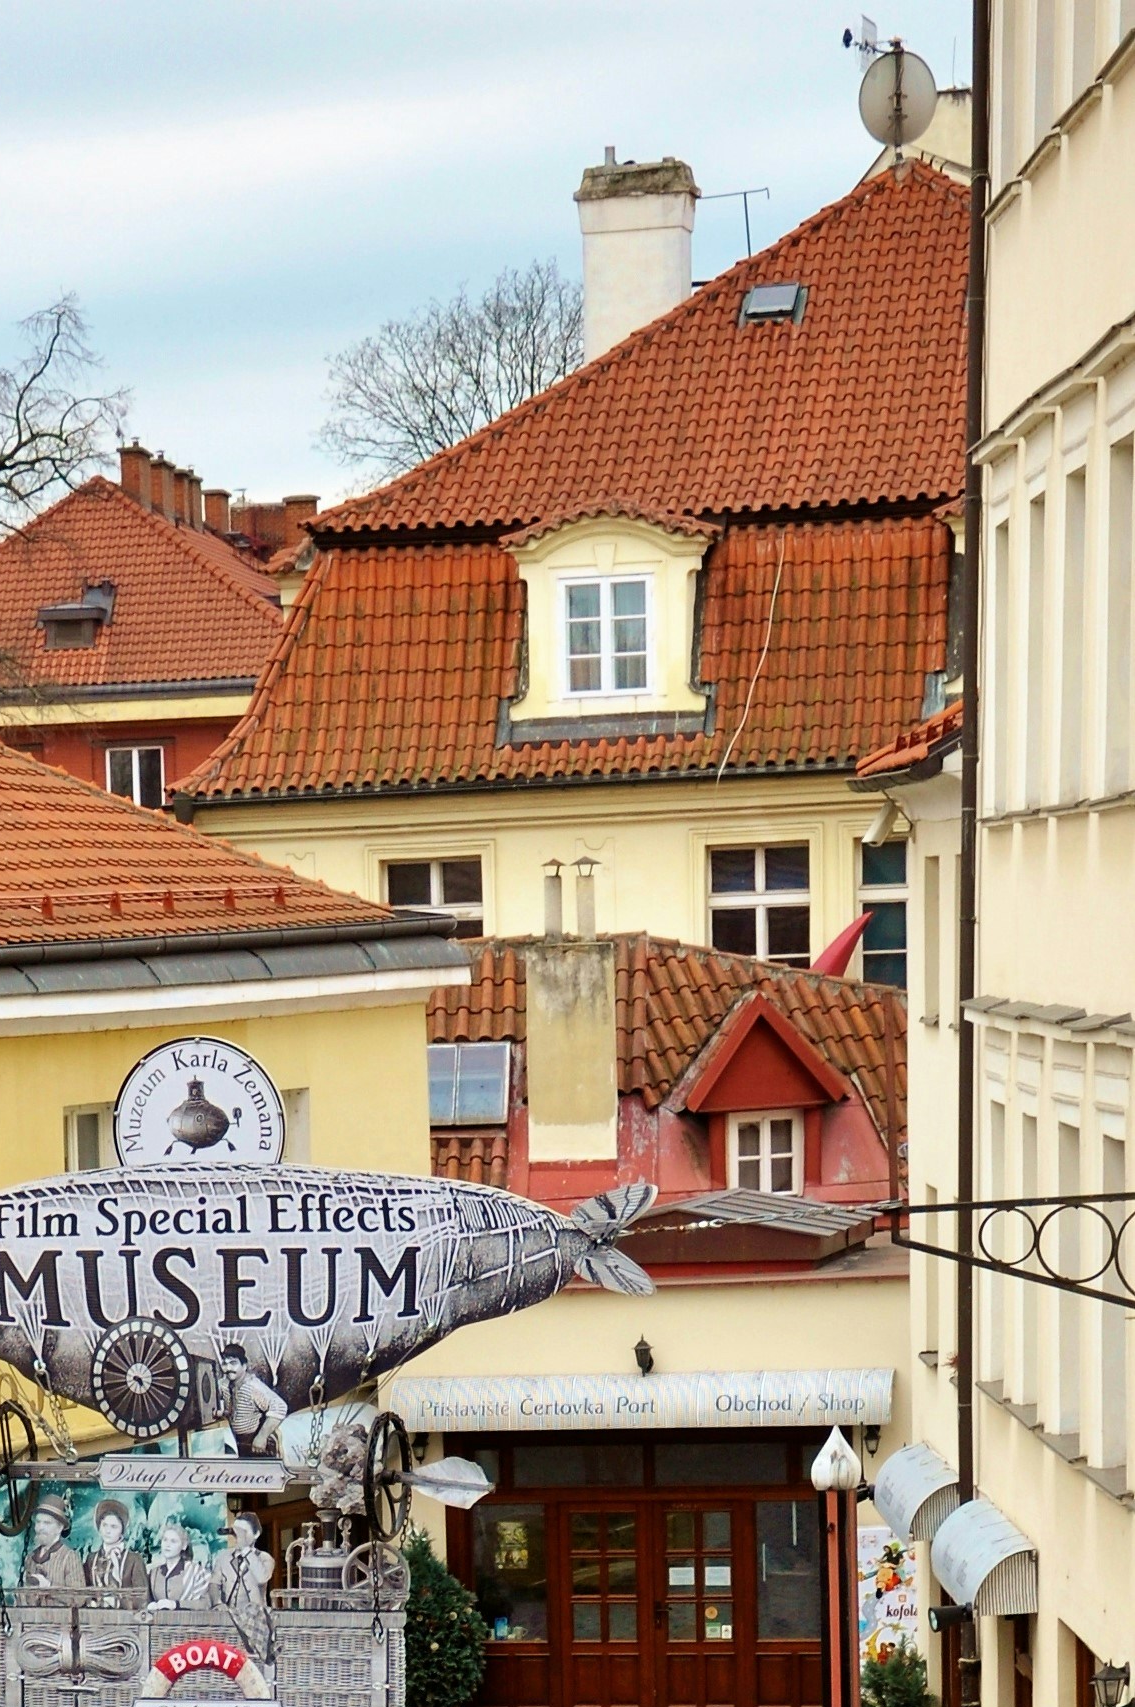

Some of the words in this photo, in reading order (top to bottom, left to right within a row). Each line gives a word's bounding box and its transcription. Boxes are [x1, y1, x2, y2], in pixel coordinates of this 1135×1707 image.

[125, 1065, 166, 1152] Muzeum
[171, 1049, 228, 1074] Karla
[232, 1063, 272, 1152] Zemana
[96, 1198, 249, 1246] Special
[269, 1194, 416, 1233] Effects
[520, 1393, 604, 1416] Čertovka
[616, 1396, 657, 1414] Port
[715, 1394, 792, 1412] Obchod
[817, 1393, 866, 1415] Shop
[108, 1463, 168, 1490] Vstup
[189, 1463, 274, 1486] Entrance
[168, 1645, 239, 1675] BOAT
